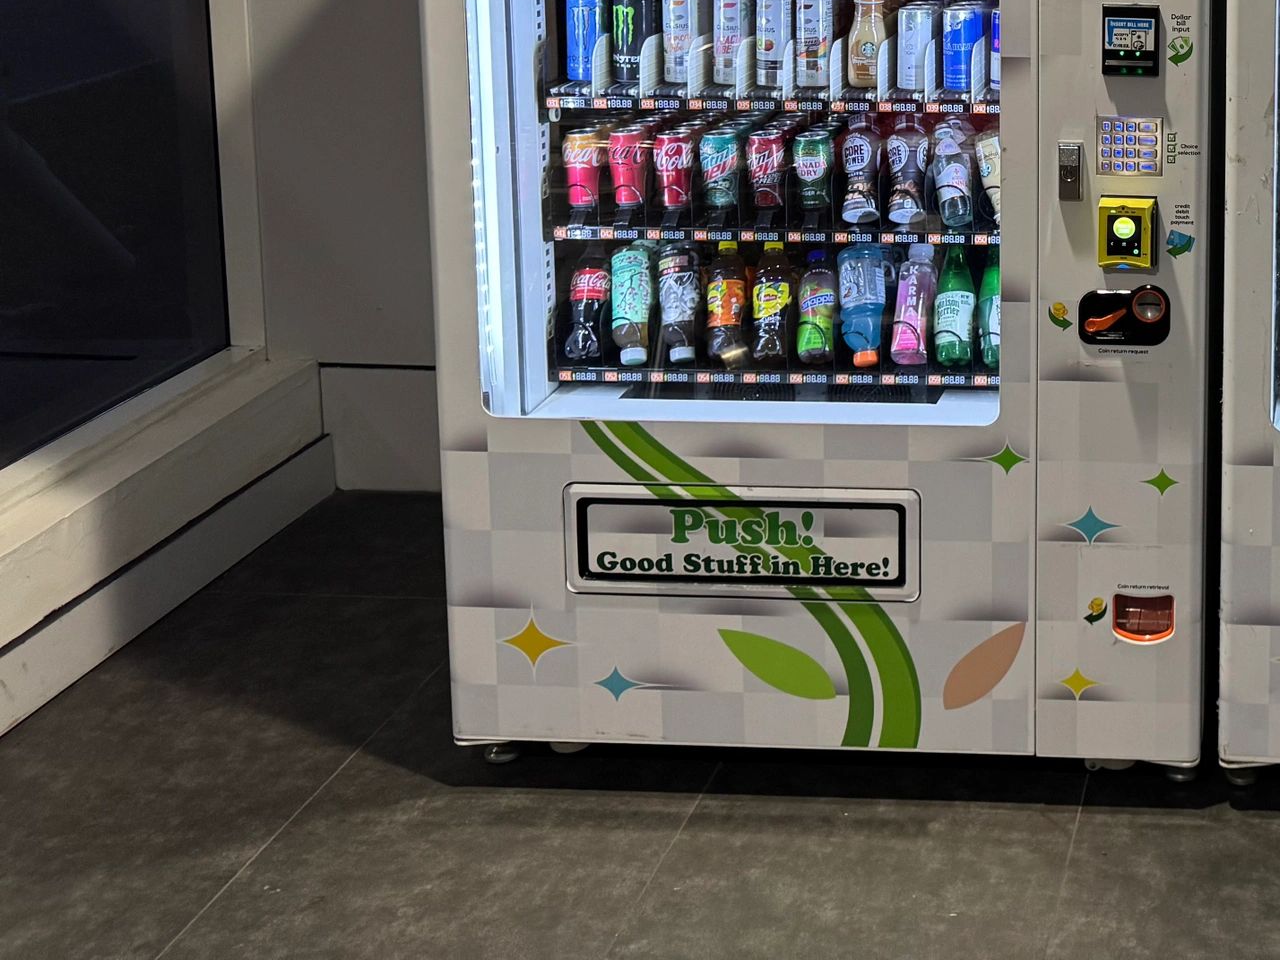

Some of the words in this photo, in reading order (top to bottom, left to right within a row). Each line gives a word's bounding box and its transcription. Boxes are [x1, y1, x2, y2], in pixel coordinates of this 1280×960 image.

[845, 145, 864, 157] CORE
[845, 157, 865, 168] POWER
[906, 265, 920, 319] KARMA
[670, 508, 815, 547] Push!
[596, 551, 674, 573] Good
[691, 553, 762, 575] Stuff
[771, 555, 800, 575] in
[811, 556, 890, 577] Here!
